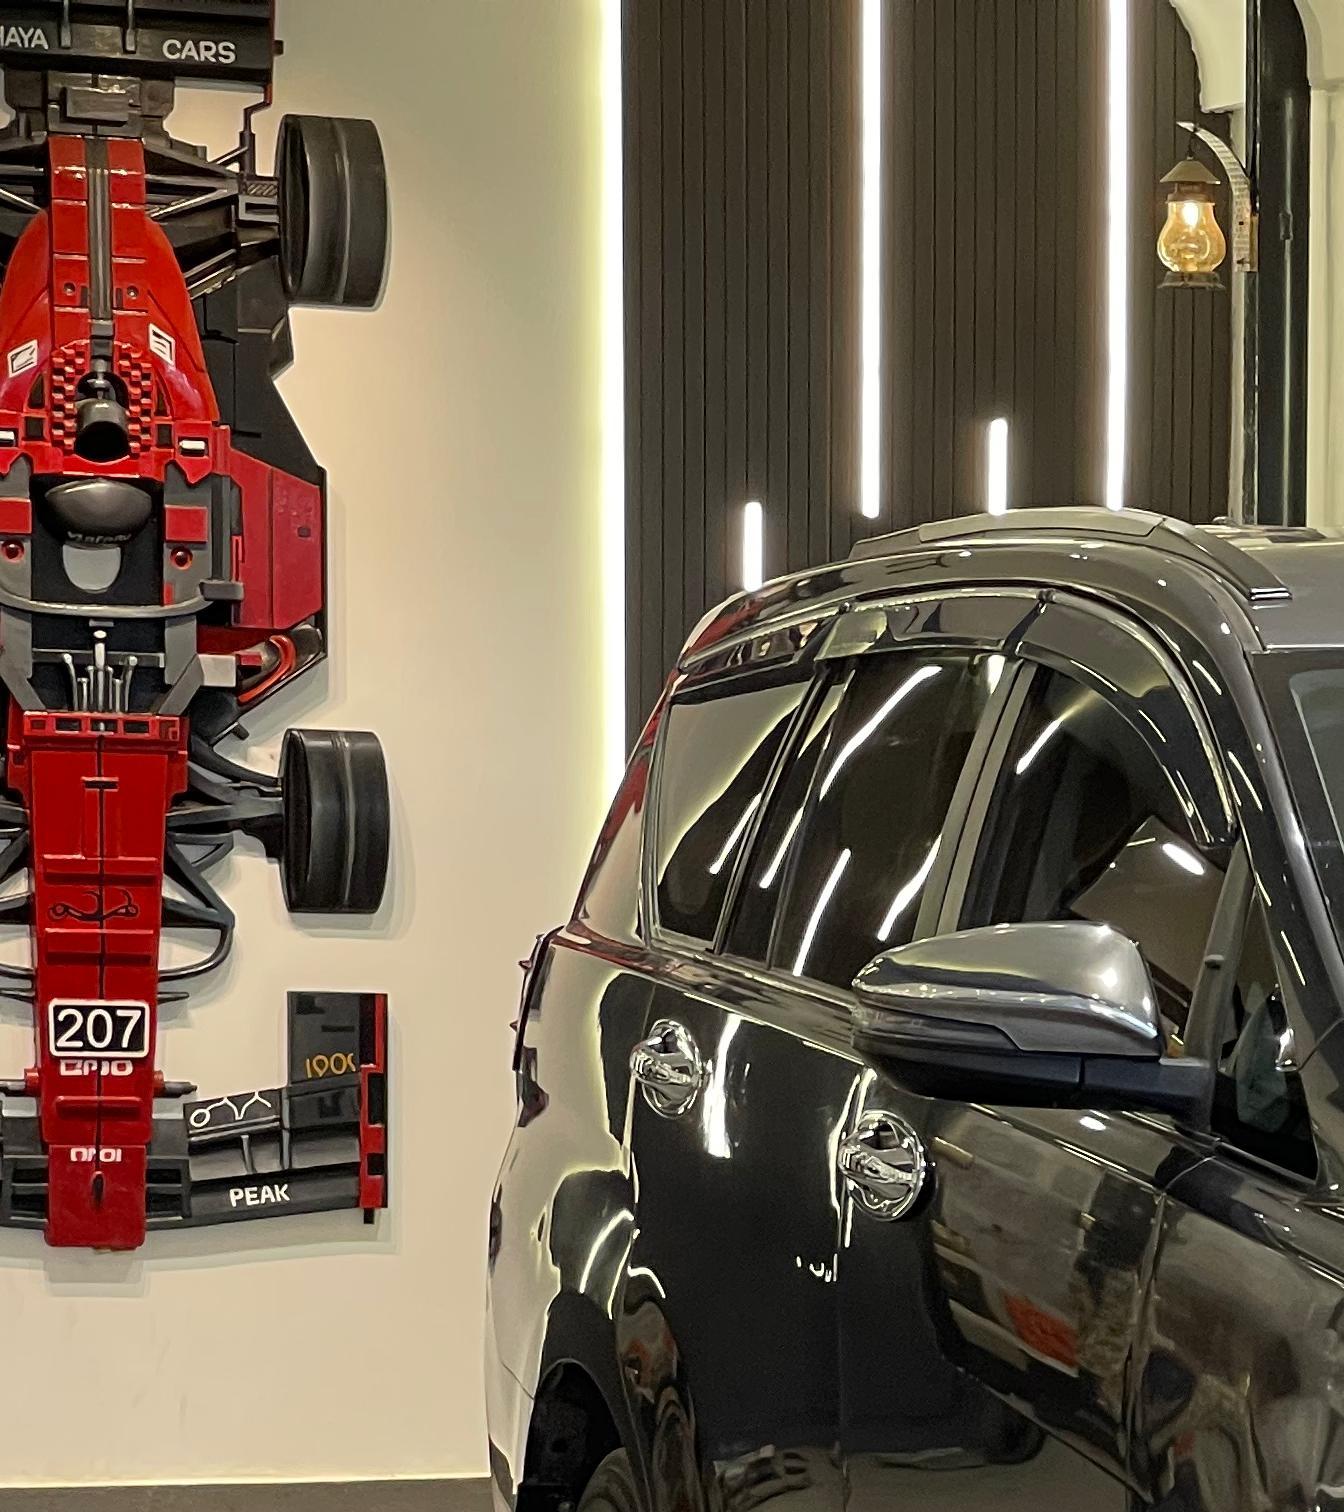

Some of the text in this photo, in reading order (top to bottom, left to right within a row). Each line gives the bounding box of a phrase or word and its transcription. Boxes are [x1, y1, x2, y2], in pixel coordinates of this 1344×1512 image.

[162, 39, 236, 64] CARS
[56, 1008, 142, 1048] 207
[229, 1184, 290, 1208] PEAK
